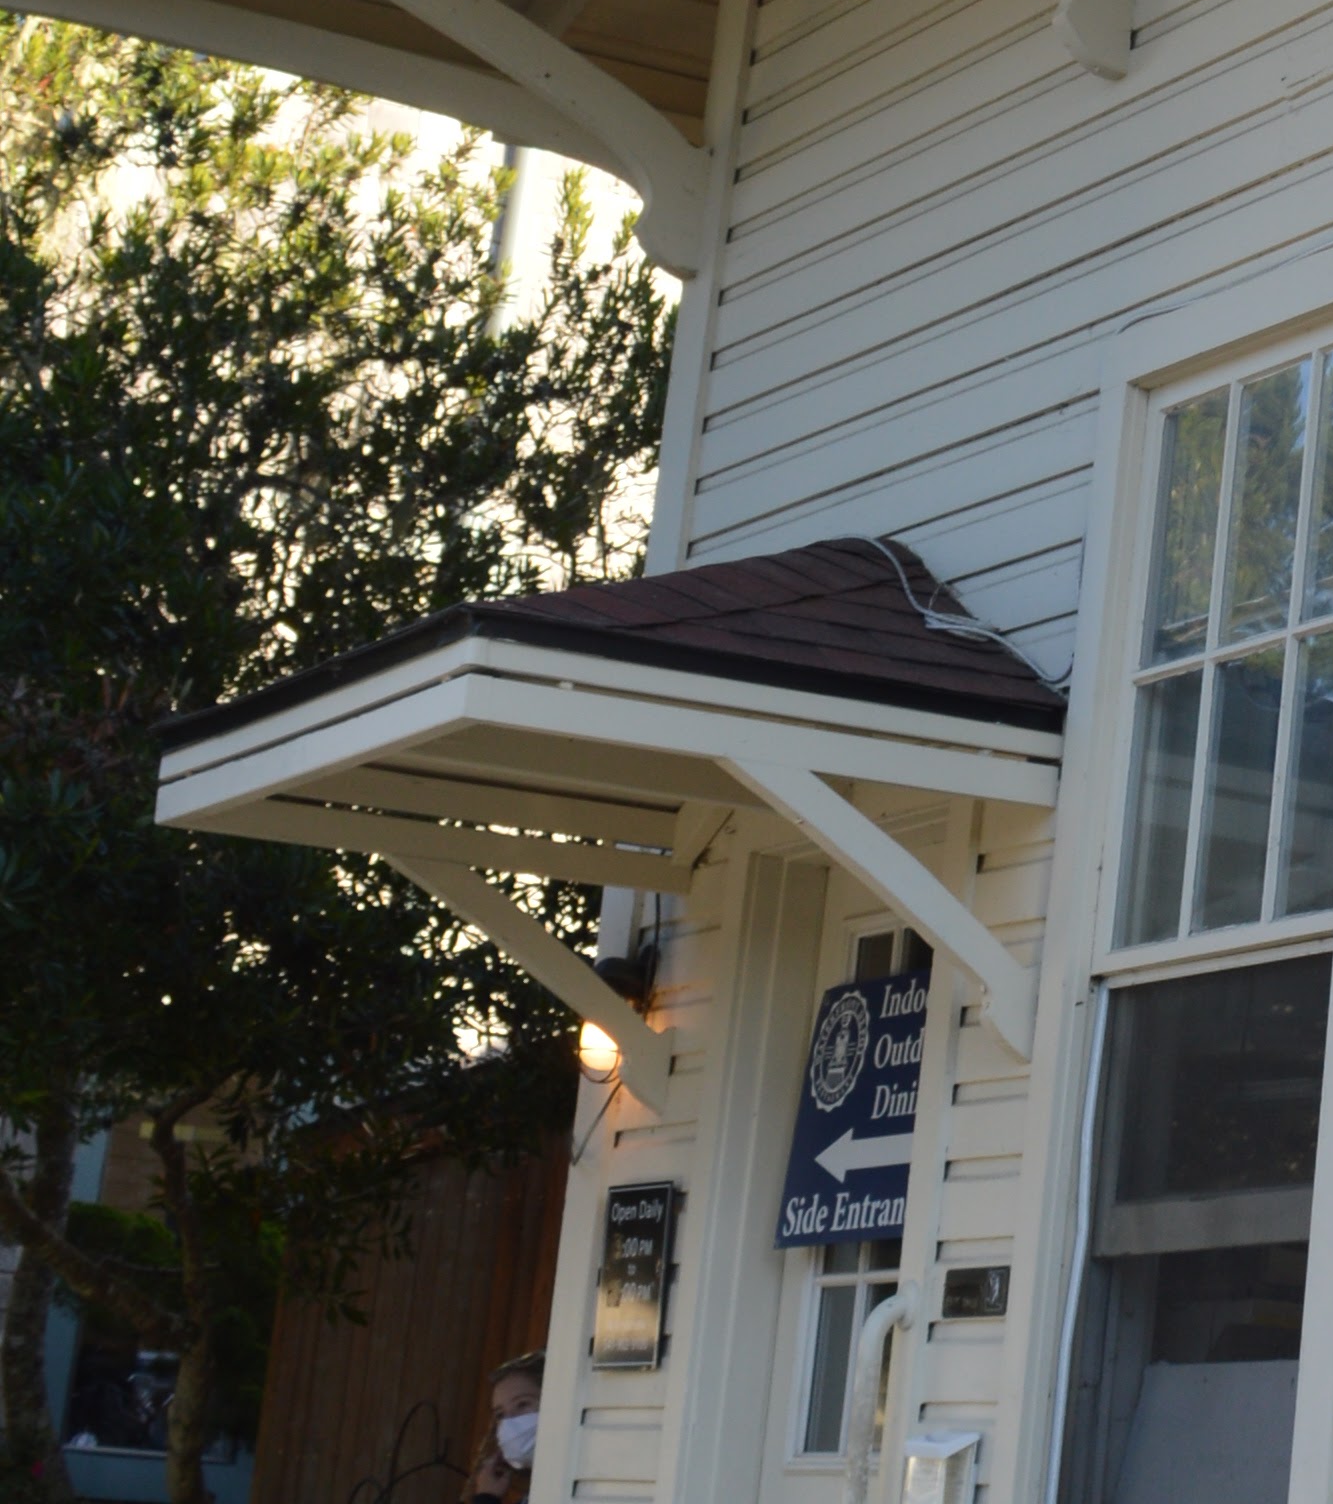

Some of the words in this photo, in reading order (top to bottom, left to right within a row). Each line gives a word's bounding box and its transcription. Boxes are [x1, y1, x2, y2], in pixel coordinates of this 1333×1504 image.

[879, 977, 926, 1018] Indo
[874, 1027, 924, 1069] Outd
[871, 1080, 917, 1120] Dini
[612, 1202, 637, 1224] Open
[639, 1198, 664, 1223] Daily
[782, 1192, 829, 1237] Side
[829, 1191, 906, 1232] Entran
